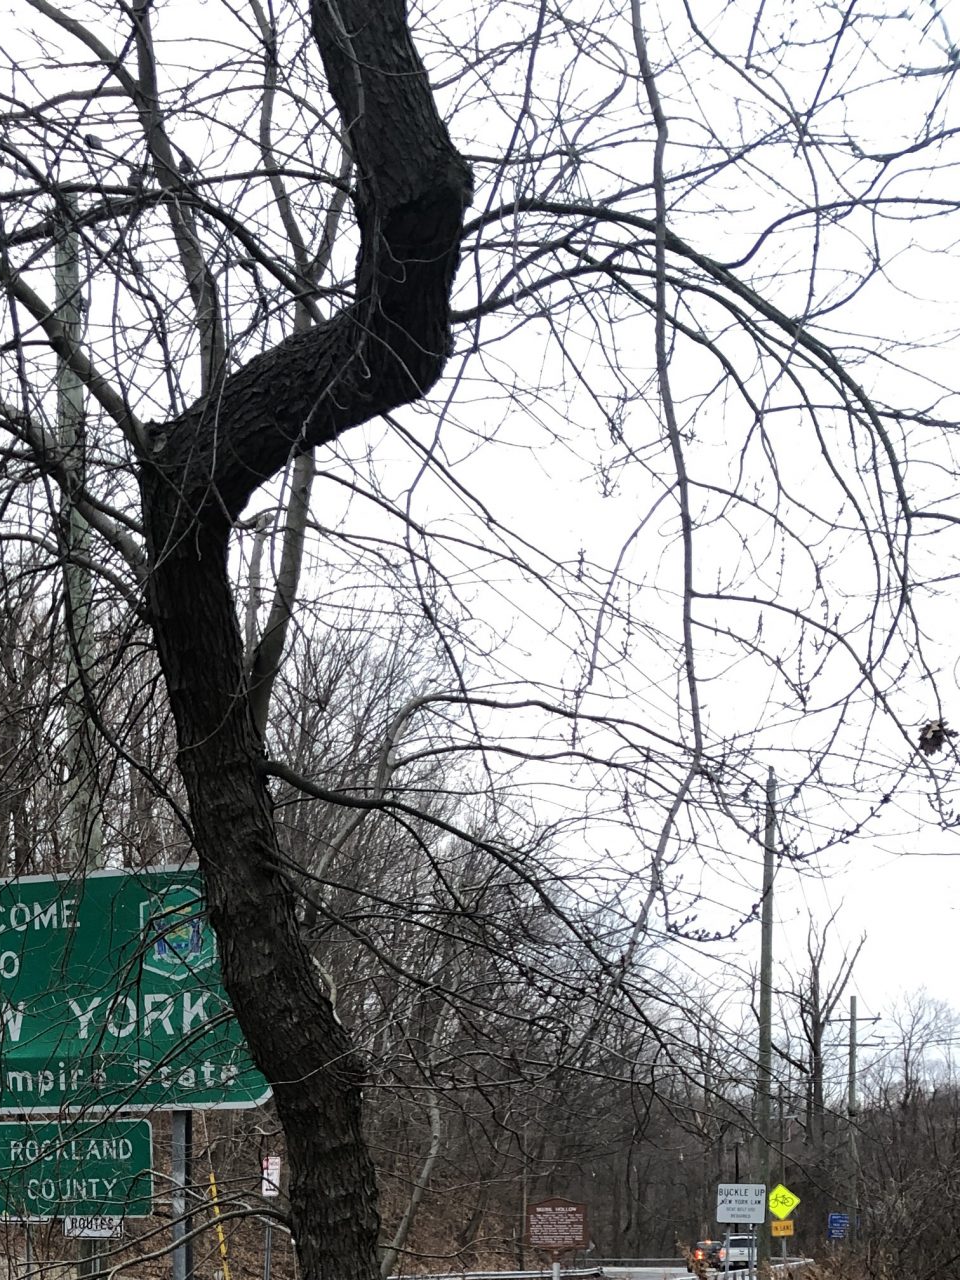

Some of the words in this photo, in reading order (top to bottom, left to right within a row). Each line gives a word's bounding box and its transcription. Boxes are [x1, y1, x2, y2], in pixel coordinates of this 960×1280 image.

[69, 992, 216, 1040] YORK
[133, 1059, 239, 1089] State
[10, 1138, 133, 1161] ROCKLAND
[27, 1178, 117, 1200] COUNTY
[719, 1188, 749, 1196] BUCKLE
[71, 1217, 114, 1230] ROUTES
